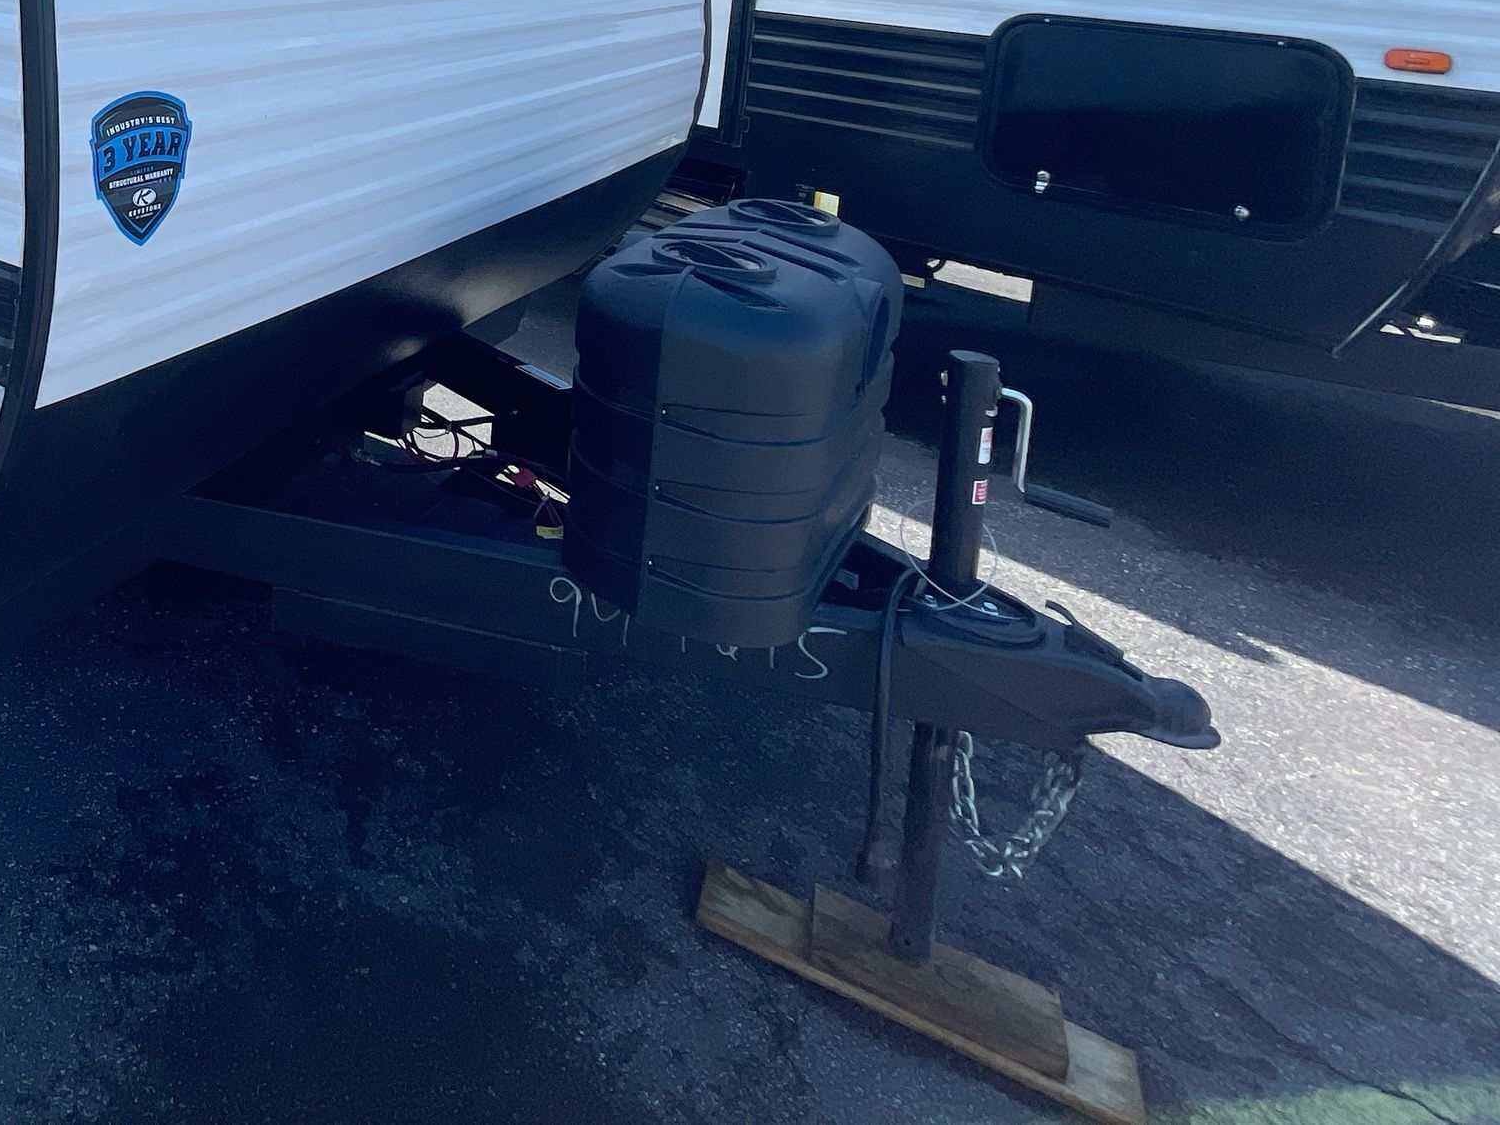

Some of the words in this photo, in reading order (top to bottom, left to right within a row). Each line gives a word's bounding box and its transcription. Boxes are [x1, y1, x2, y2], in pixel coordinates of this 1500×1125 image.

[106, 116, 153, 137] INDUSTRY'S
[155, 116, 176, 125] BEST
[103, 145, 116, 174] 3
[122, 130, 183, 162] YEAR
[108, 174, 144, 190] STRUCTURAL
[144, 168, 174, 181] WARRANTY
[128, 203, 162, 217] KEYSTONE
